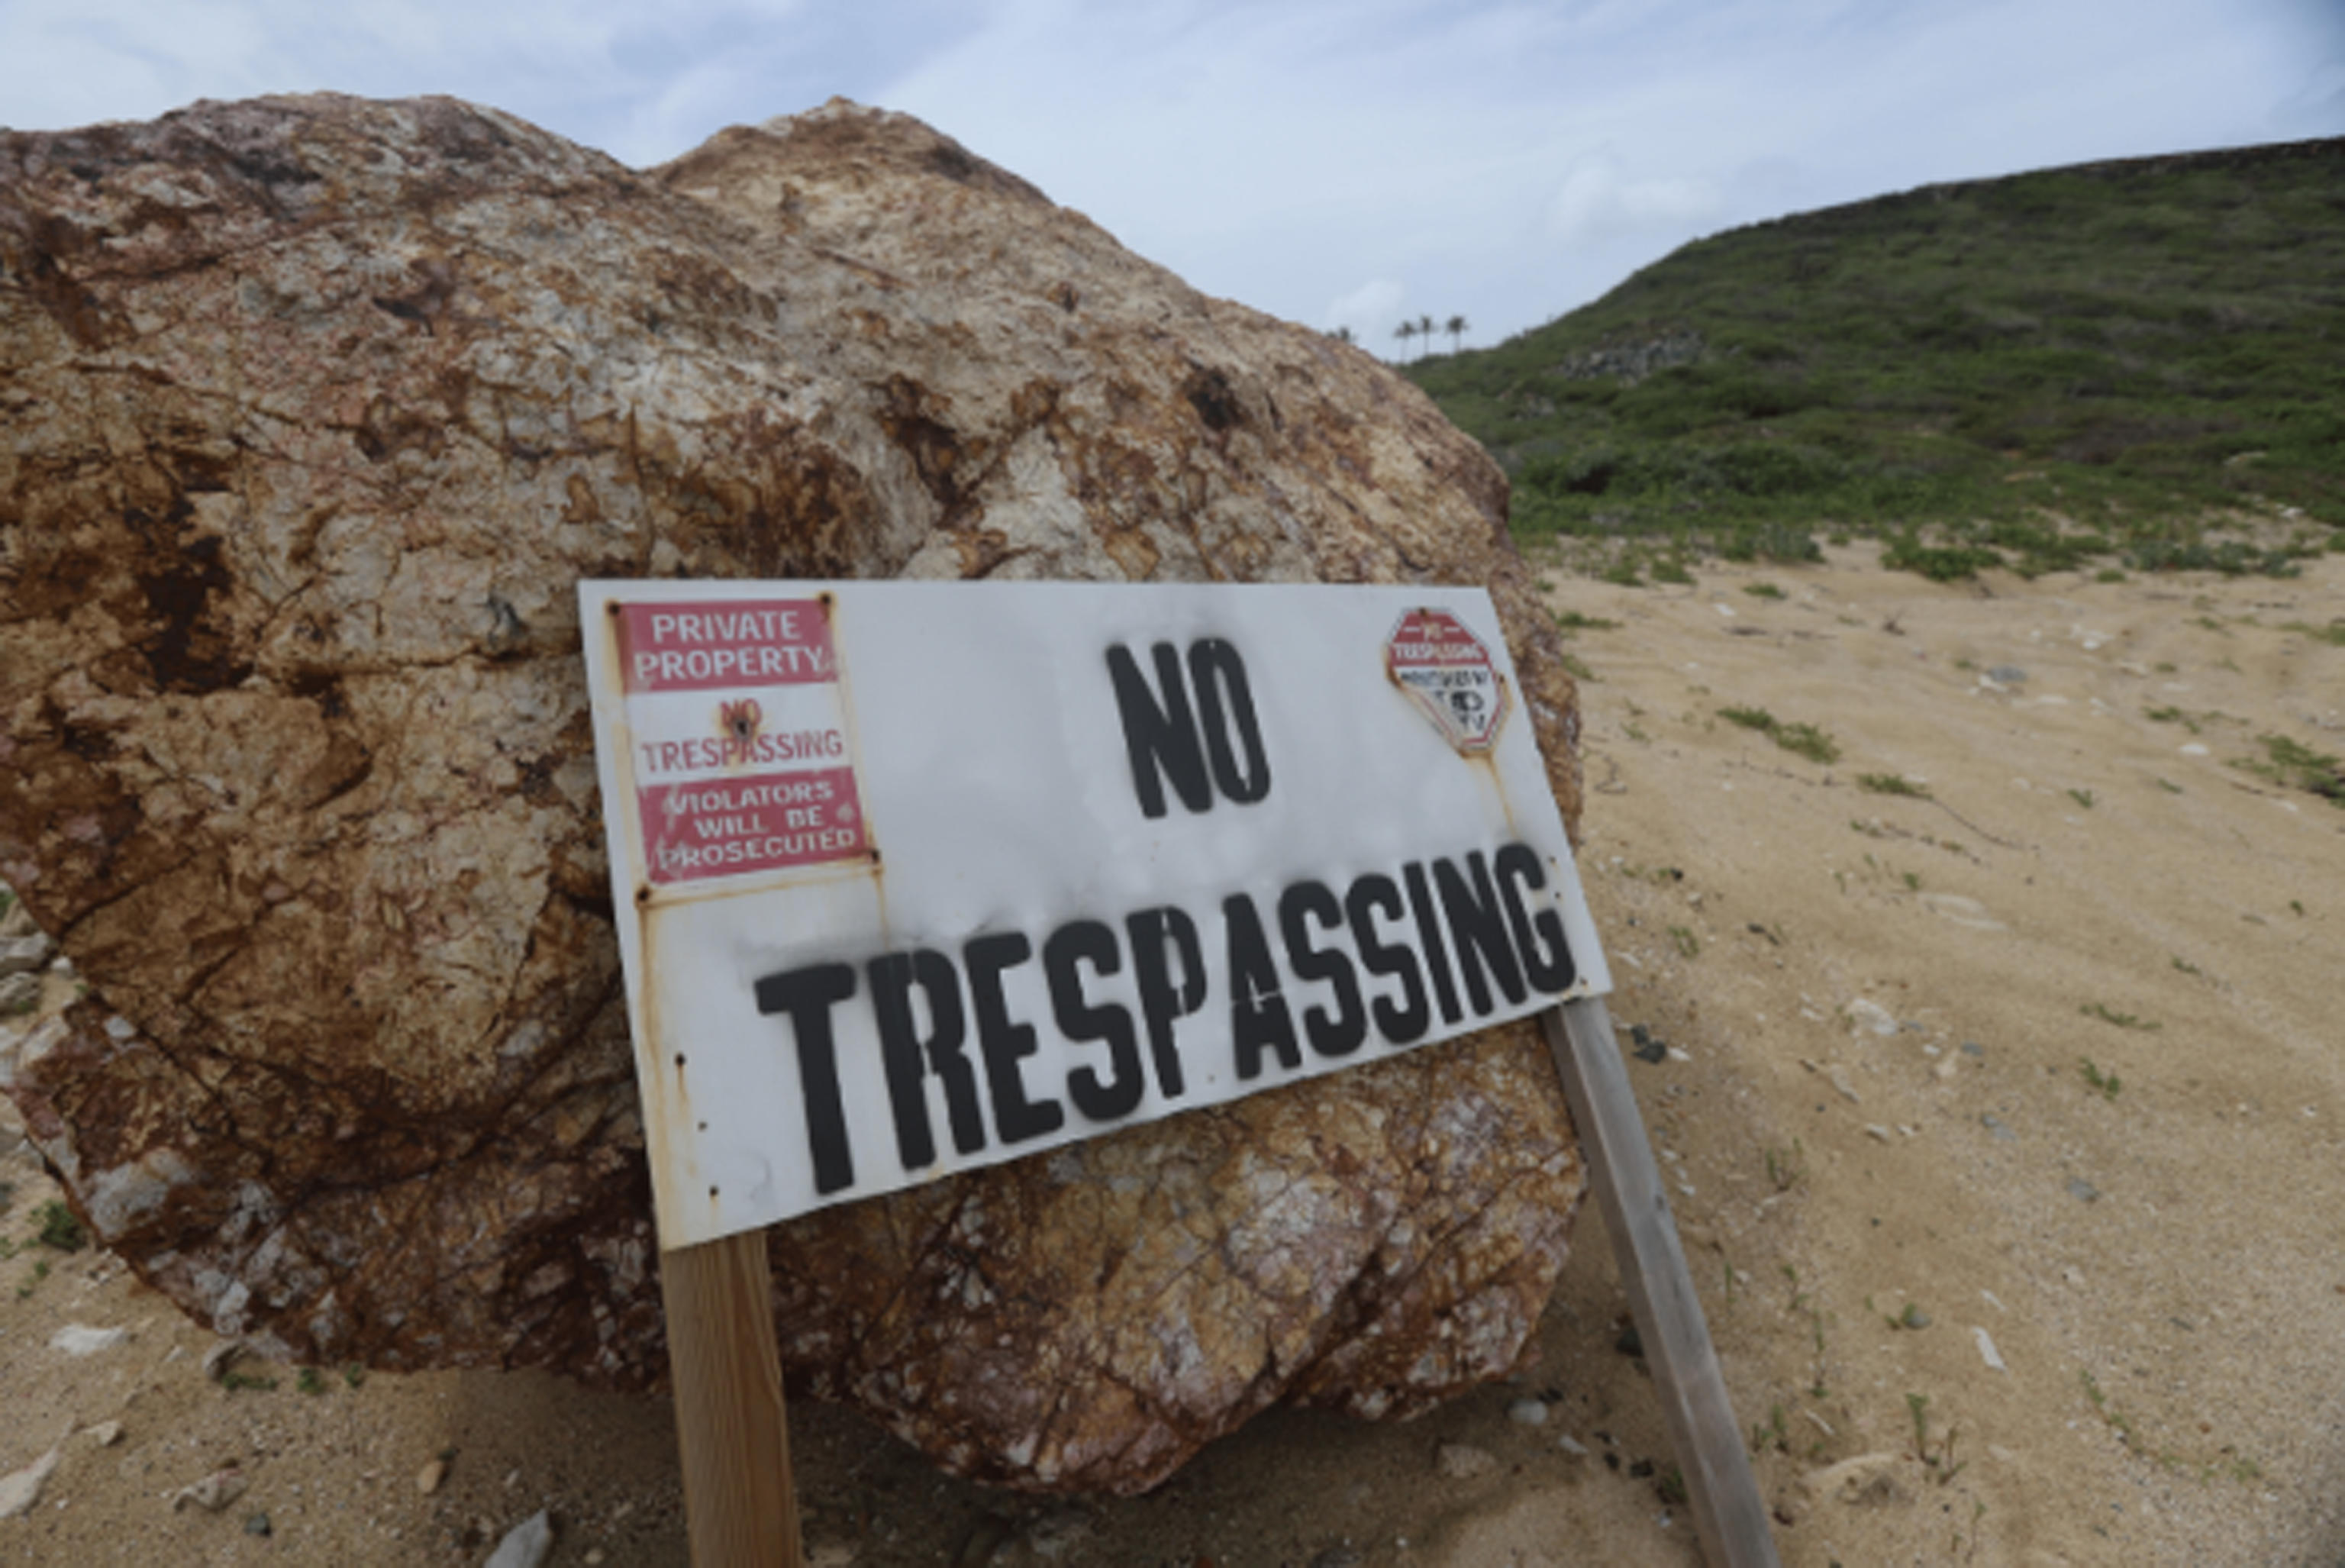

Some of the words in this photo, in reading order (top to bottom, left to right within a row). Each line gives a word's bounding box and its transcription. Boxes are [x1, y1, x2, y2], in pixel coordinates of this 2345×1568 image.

[650, 610, 802, 644] PRIVATE
[634, 645, 824, 682] PROPERTY
[719, 698, 763, 729] NO
[1104, 637, 1271, 819] NO
[640, 729, 843, 773] TRESPASSING
[667, 780, 836, 815] VIOLATORS
[694, 812, 769, 839] WILL
[785, 805, 824, 830] BE
[658, 828, 856, 870] PROSECUTED
[753, 842, 1578, 1197] TRESPASSING
